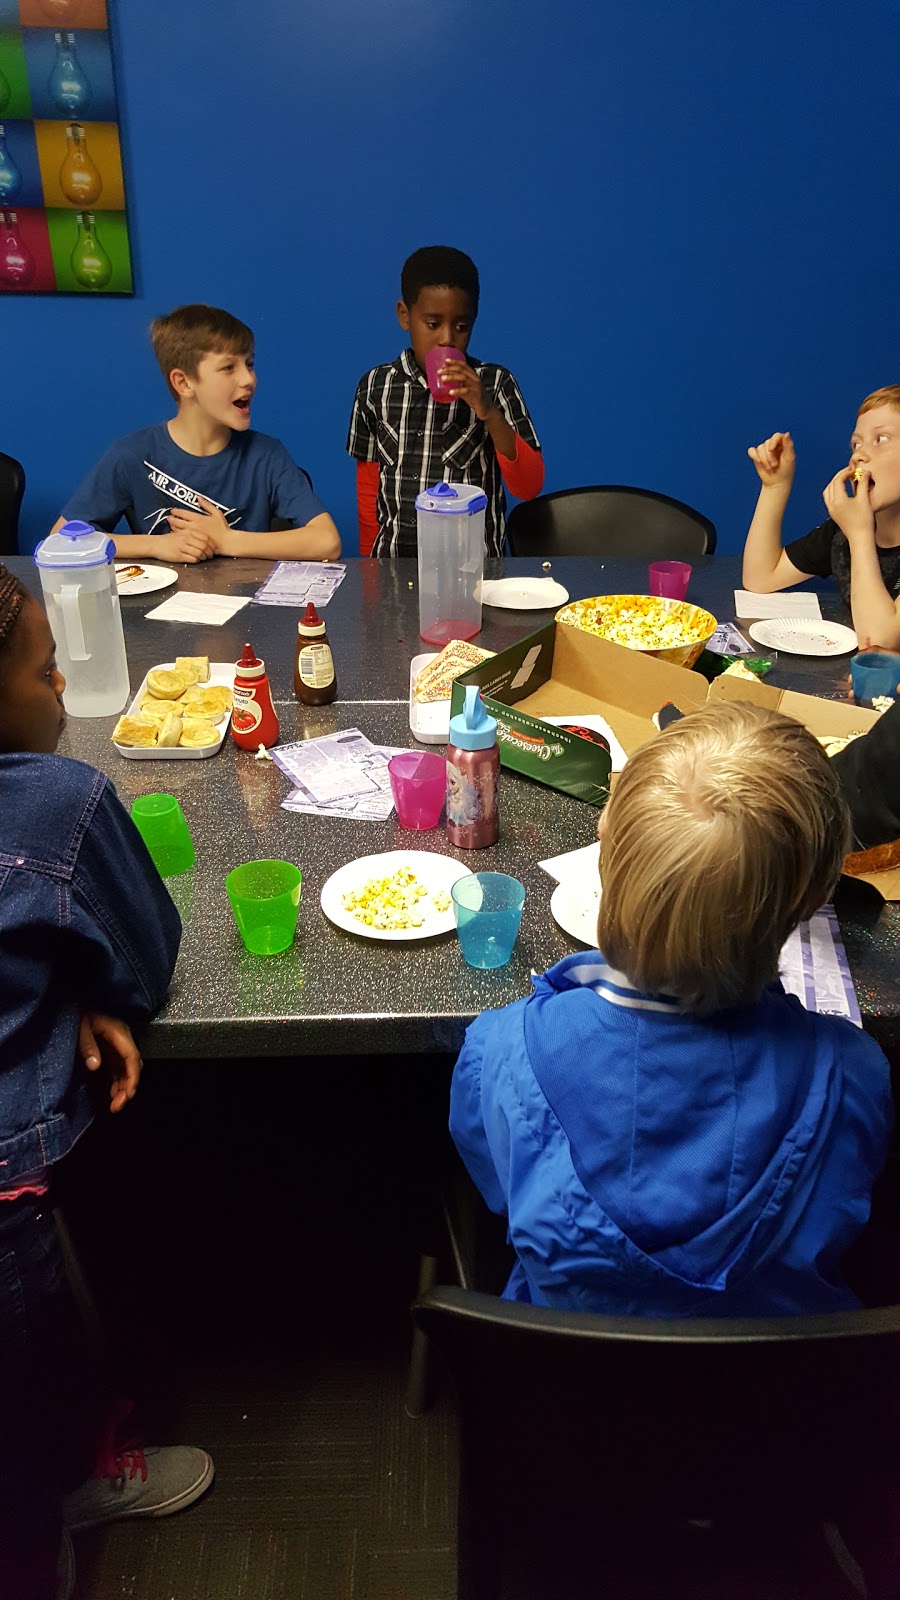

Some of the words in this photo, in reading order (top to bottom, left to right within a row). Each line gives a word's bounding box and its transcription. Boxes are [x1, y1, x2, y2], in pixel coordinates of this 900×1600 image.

[148, 471, 169, 489] AIR
[496, 731, 551, 760] Cheesecake
[550, 743, 563, 755] The
